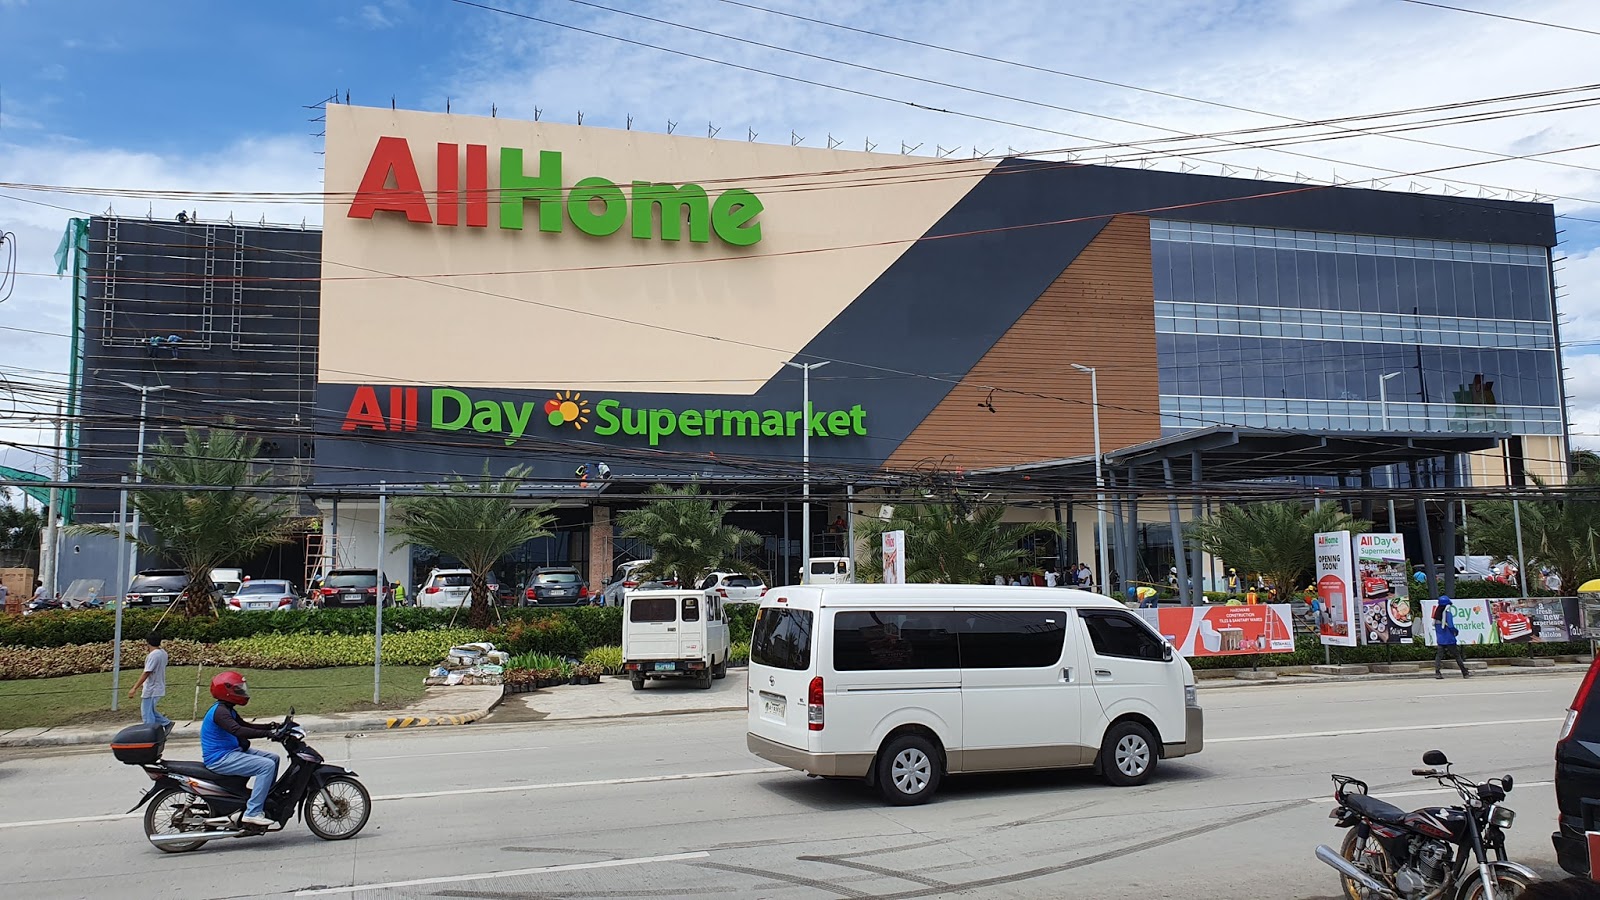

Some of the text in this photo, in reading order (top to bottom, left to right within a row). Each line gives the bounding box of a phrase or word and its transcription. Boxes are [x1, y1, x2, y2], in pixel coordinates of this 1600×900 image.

[347, 136, 764, 246] AllHome
[341, 386, 868, 446] All Day Supermarket
[1360, 536, 1391, 547] All Day
[1361, 547, 1401, 556] Supermarket
[1318, 555, 1341, 563] OPENING
[1322, 562, 1338, 570] SOON!
[1449, 605, 1471, 621] Day
